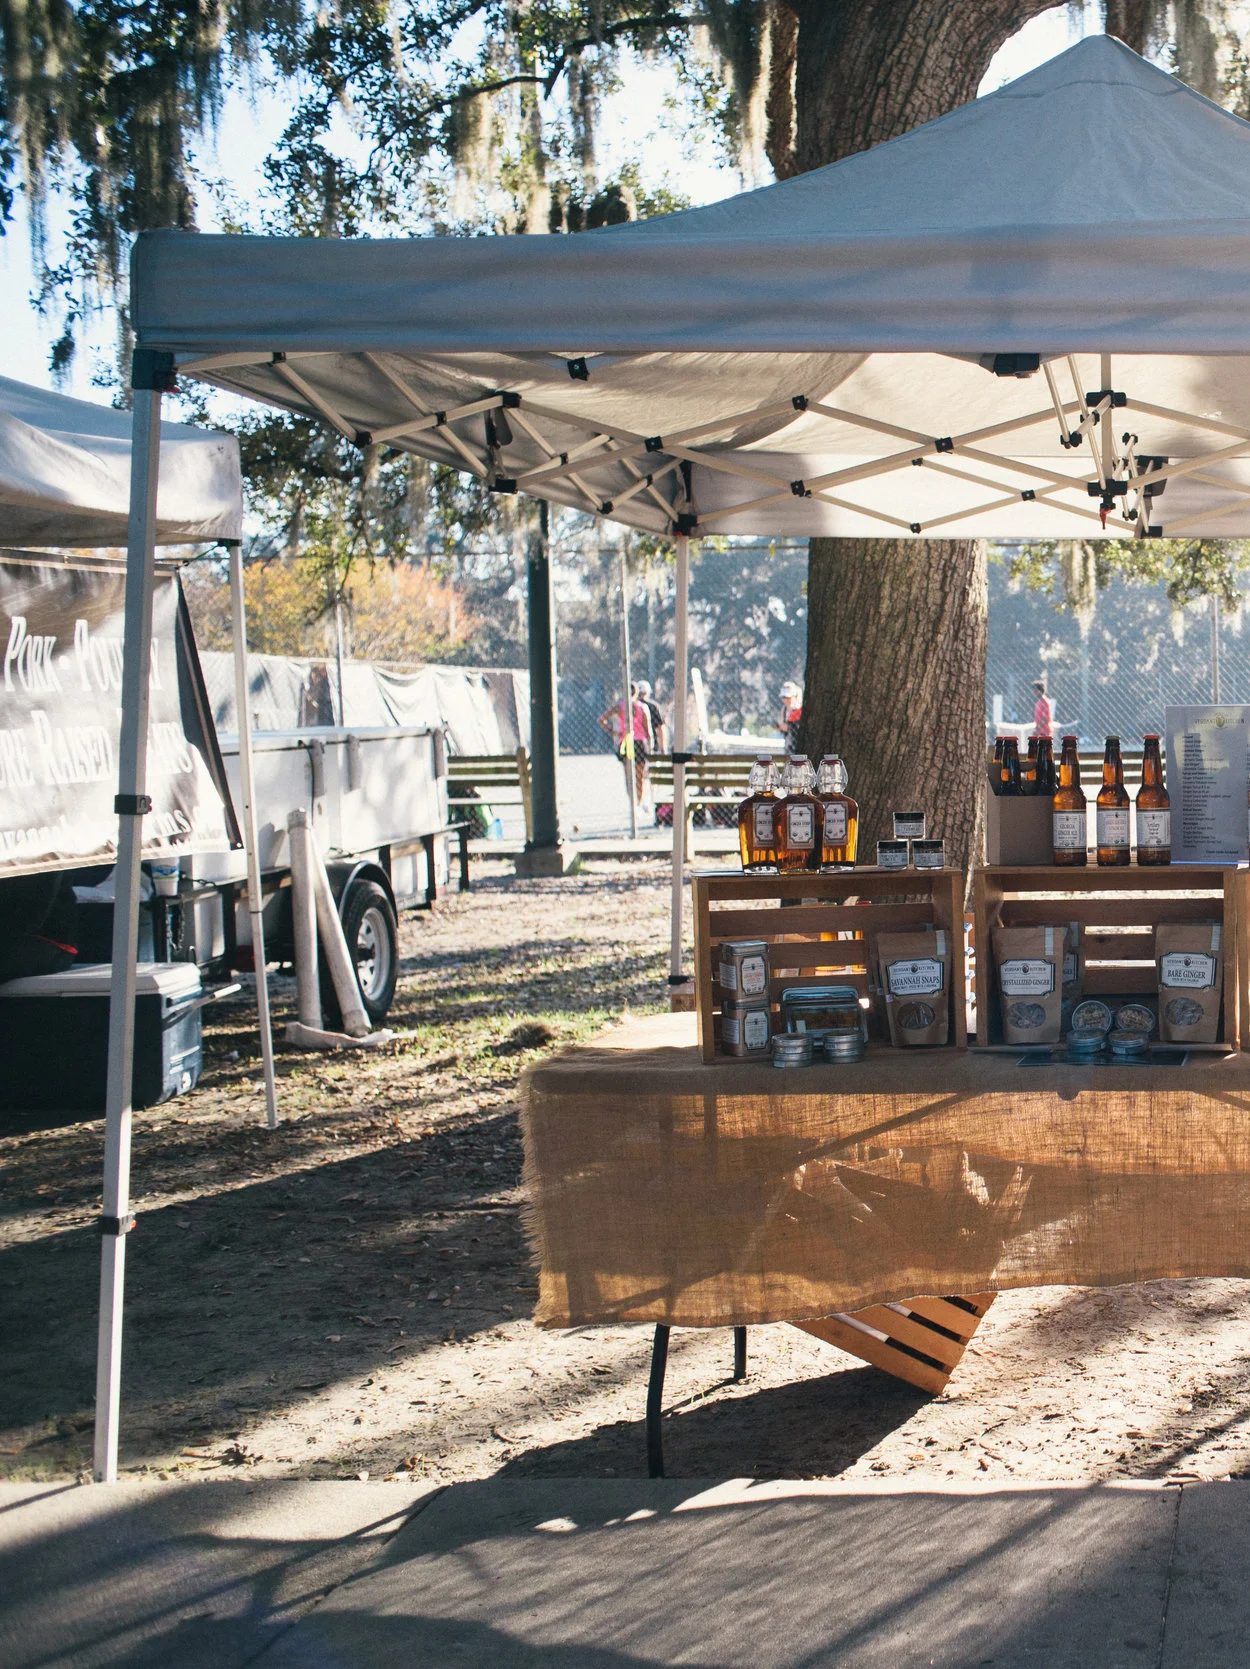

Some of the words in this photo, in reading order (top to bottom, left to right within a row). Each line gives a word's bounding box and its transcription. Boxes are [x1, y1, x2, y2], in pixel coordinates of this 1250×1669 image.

[1167, 969, 1182, 978] BARE
[1182, 970, 1206, 980] GINGER
[891, 976, 921, 987] SAVANNAH
[921, 975, 940, 985] SNAPS
